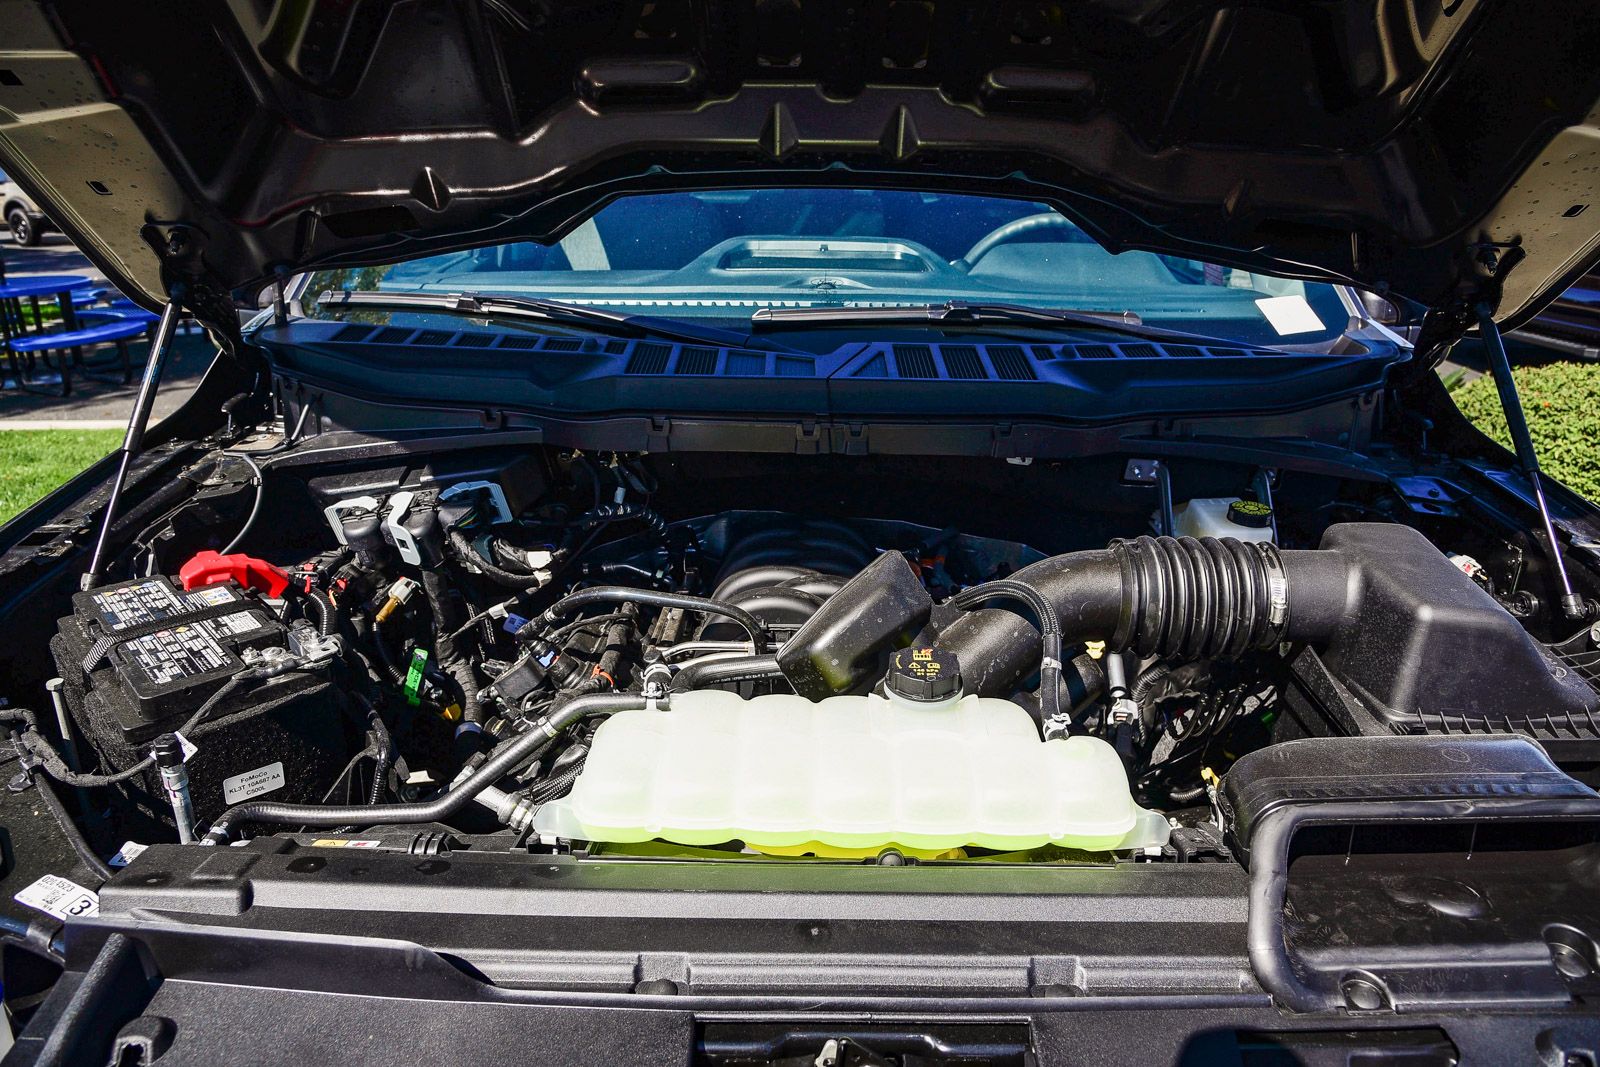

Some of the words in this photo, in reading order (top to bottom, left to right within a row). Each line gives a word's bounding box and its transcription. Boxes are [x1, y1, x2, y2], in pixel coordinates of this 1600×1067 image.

[241, 772, 268, 783] FoMoCo
[229, 785, 246, 794] KL3T
[69, 899, 92, 916] 3
